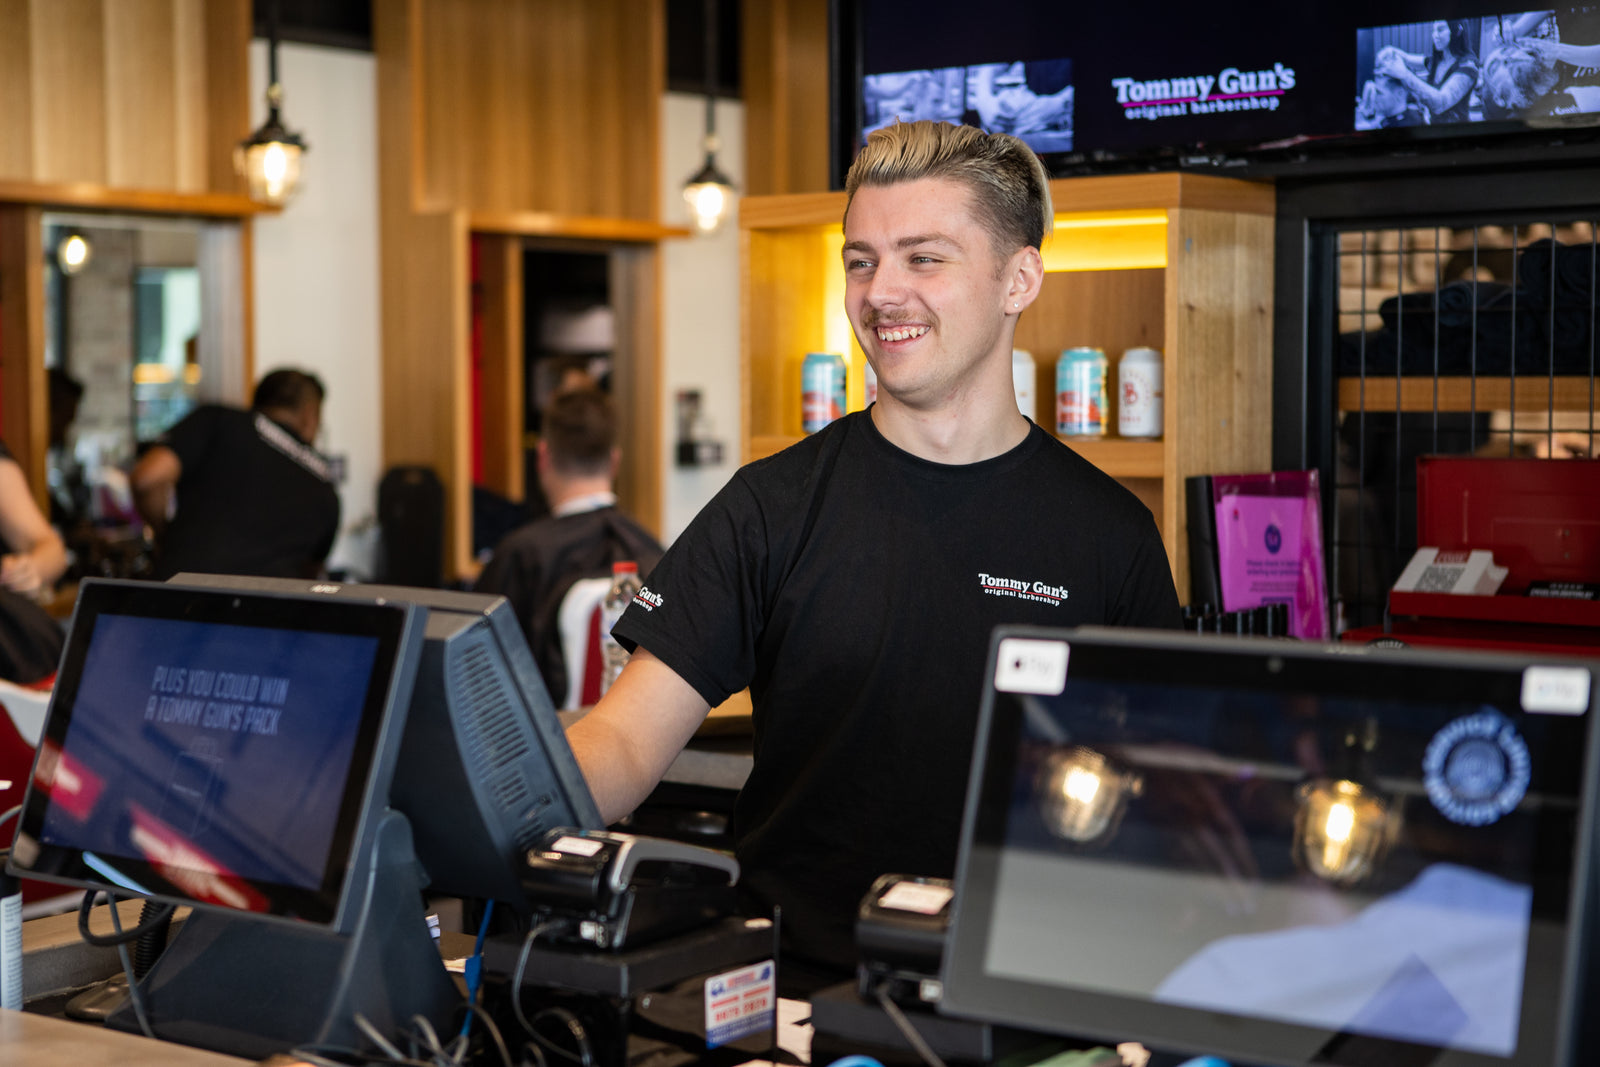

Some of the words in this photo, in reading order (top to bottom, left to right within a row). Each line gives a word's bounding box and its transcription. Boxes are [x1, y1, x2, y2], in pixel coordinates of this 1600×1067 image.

[1111, 75, 1215, 103] Tommy
[1218, 62, 1296, 94] Gun's
[1125, 102, 1187, 120] original
[1190, 96, 1280, 114] barbershop
[639, 586, 664, 607] Gun's
[978, 573, 1030, 593] Tommy
[1032, 581, 1069, 599] Gun's
[984, 588, 1016, 597] original
[1018, 592, 1060, 607] barbershop
[152, 665, 187, 693] PLUS
[186, 669, 217, 697] YOU
[213, 671, 260, 702] COULD
[258, 676, 290, 705] WIN
[144, 695, 158, 720] A
[156, 696, 205, 726] TOMMY
[241, 705, 283, 736] PACK
